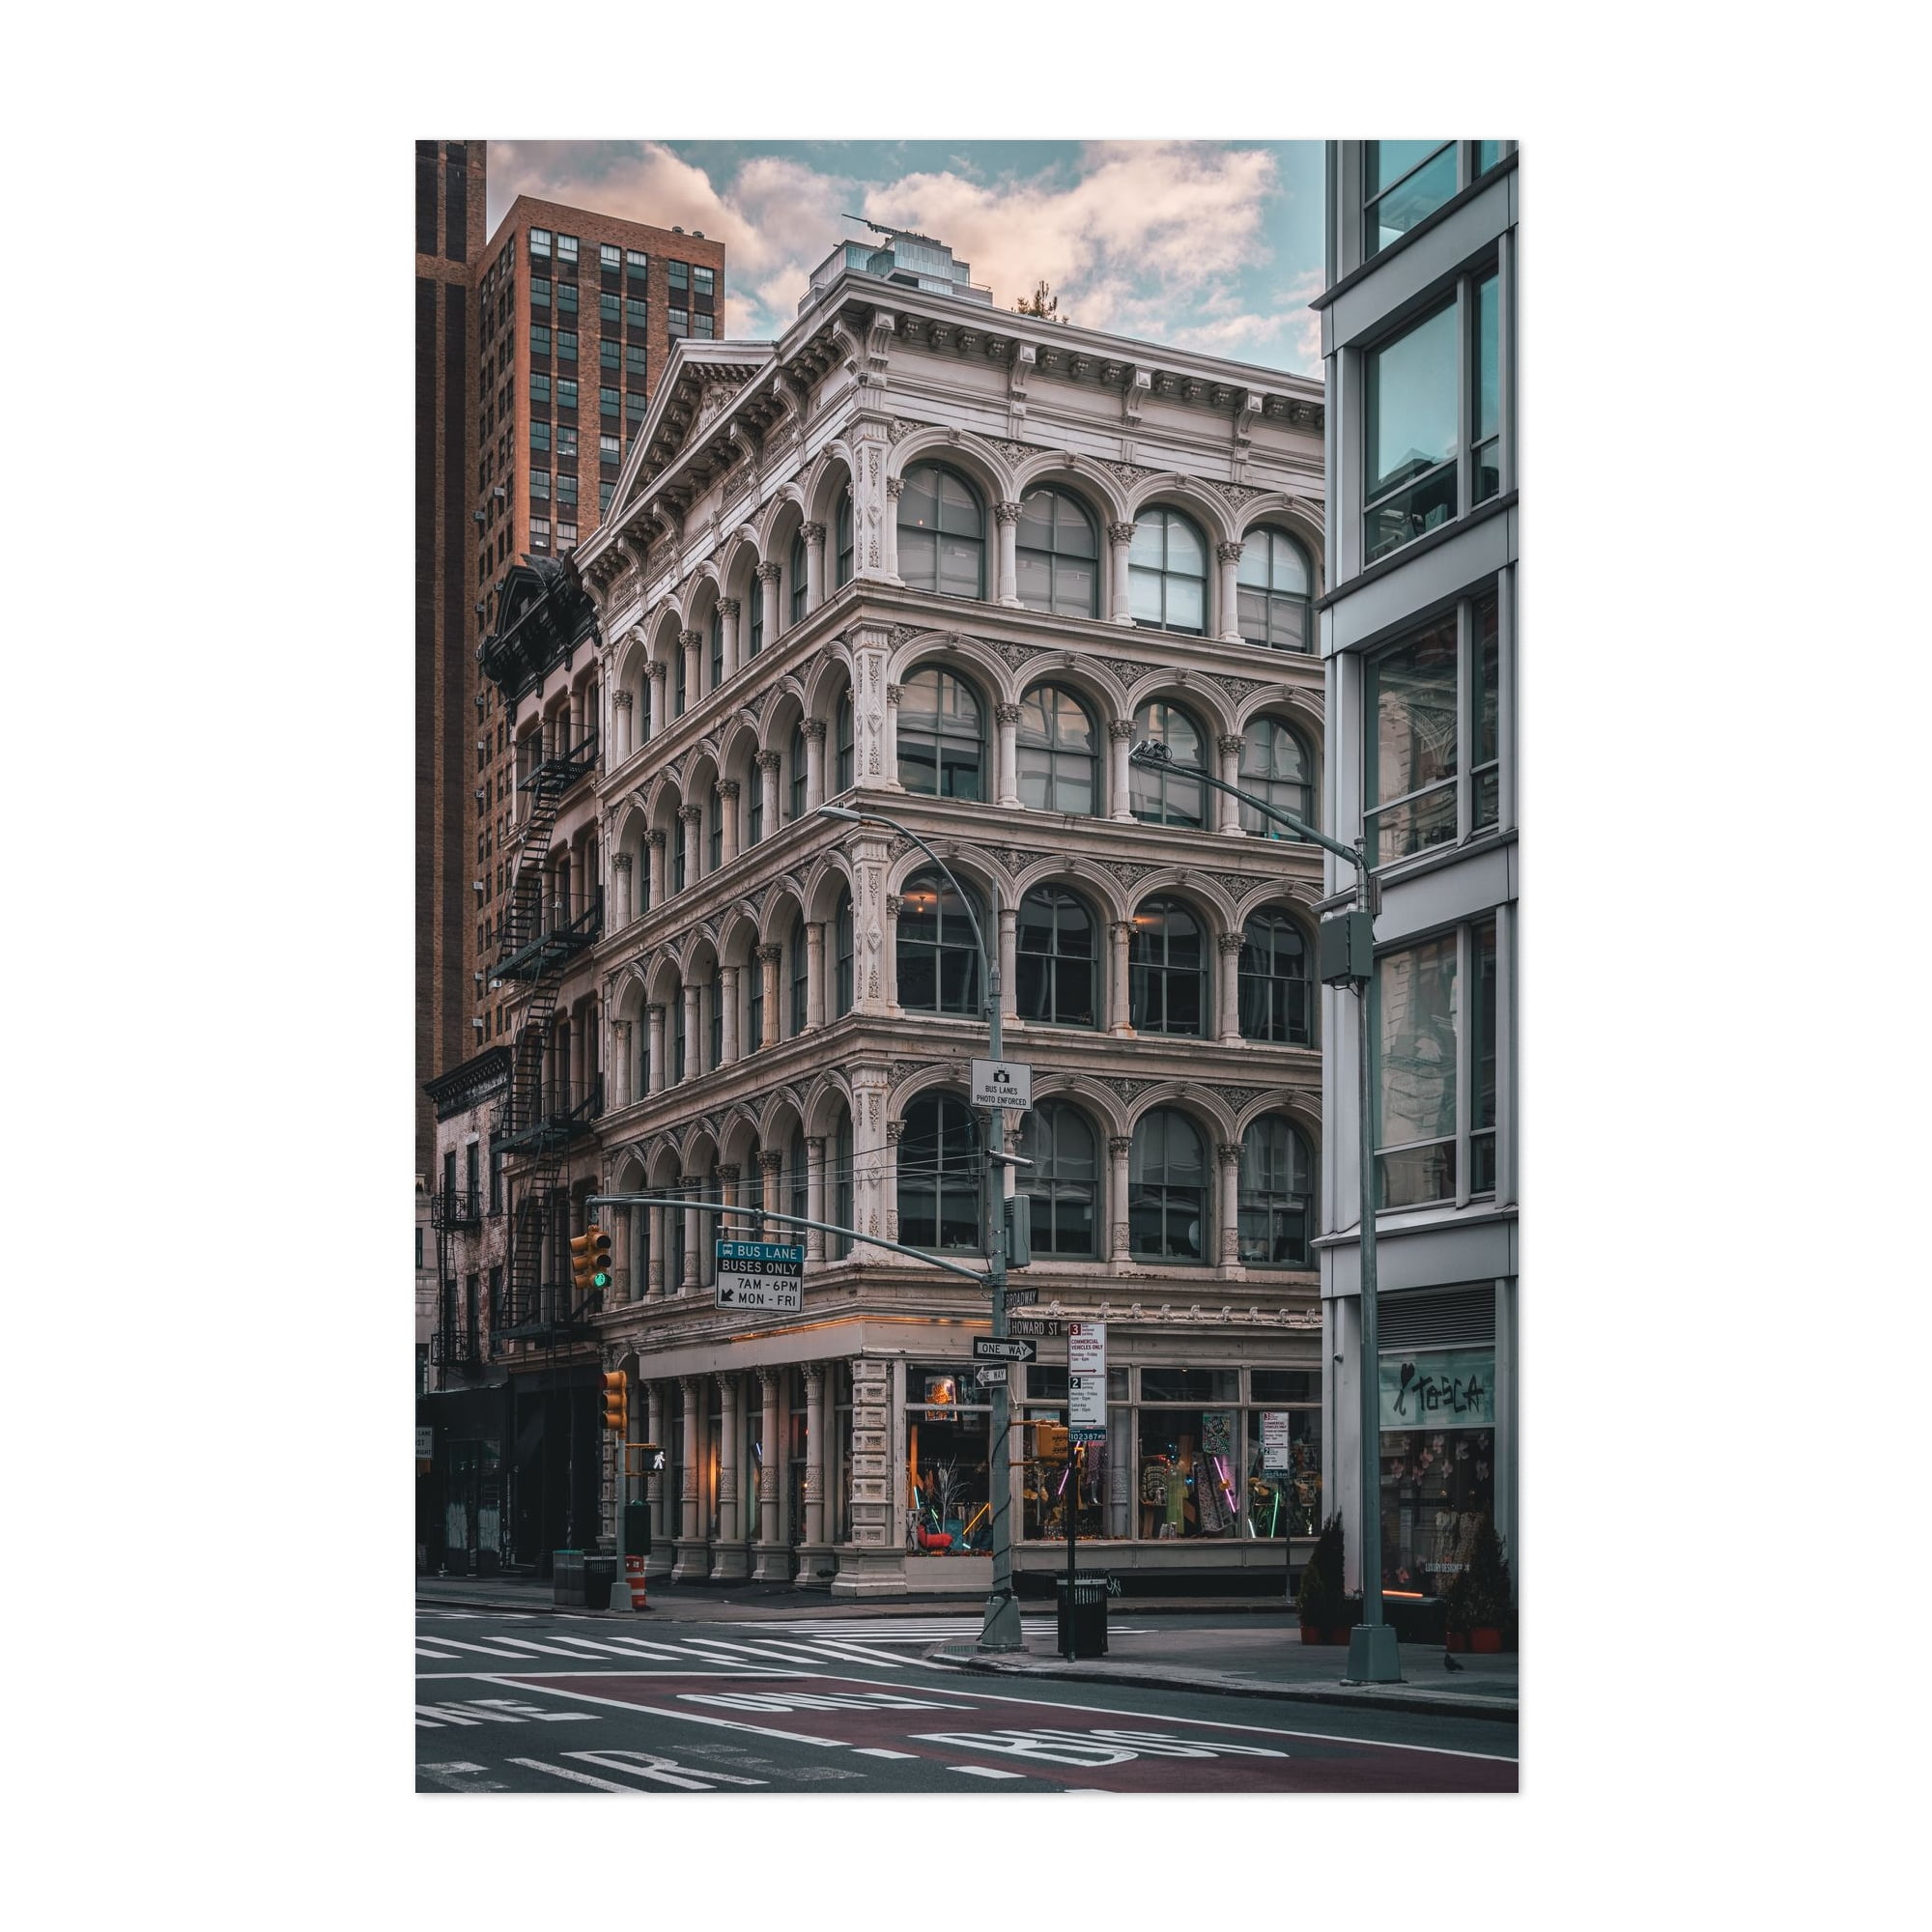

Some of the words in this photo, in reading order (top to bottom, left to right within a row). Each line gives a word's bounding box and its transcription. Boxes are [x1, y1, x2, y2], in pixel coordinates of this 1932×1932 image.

[985, 1085, 997, 1094] BUS
[999, 1087, 1018, 1095] LANES
[977, 1094, 996, 1103] PHOTO
[997, 1096, 1027, 1106] ENFORCED
[737, 1245, 761, 1258] BUS
[766, 1247, 798, 1260] LANE
[722, 1260, 762, 1272] BUSES
[766, 1263, 797, 1275] ONLY
[737, 1277, 762, 1290] 7AM
[773, 1281, 798, 1293] 6PM
[738, 1293, 764, 1305] MON
[777, 1294, 797, 1307] FRI
[1006, 1290, 1037, 1308] BROADWAY
[1011, 1321, 1044, 1335] HOWARD
[1048, 1321, 1059, 1336] ST
[1072, 1324, 1079, 1335] 3
[982, 1344, 1001, 1353] ONE
[1008, 1345, 1028, 1355] WAY
[979, 1372, 990, 1381] ONE
[993, 1369, 1006, 1381] WAY
[1072, 1378, 1079, 1388] 2
[1411, 1374, 1485, 1414] TOSCA
[676, 1692, 980, 1713] ONLY
[906, 1728, 1292, 1768] BUS
